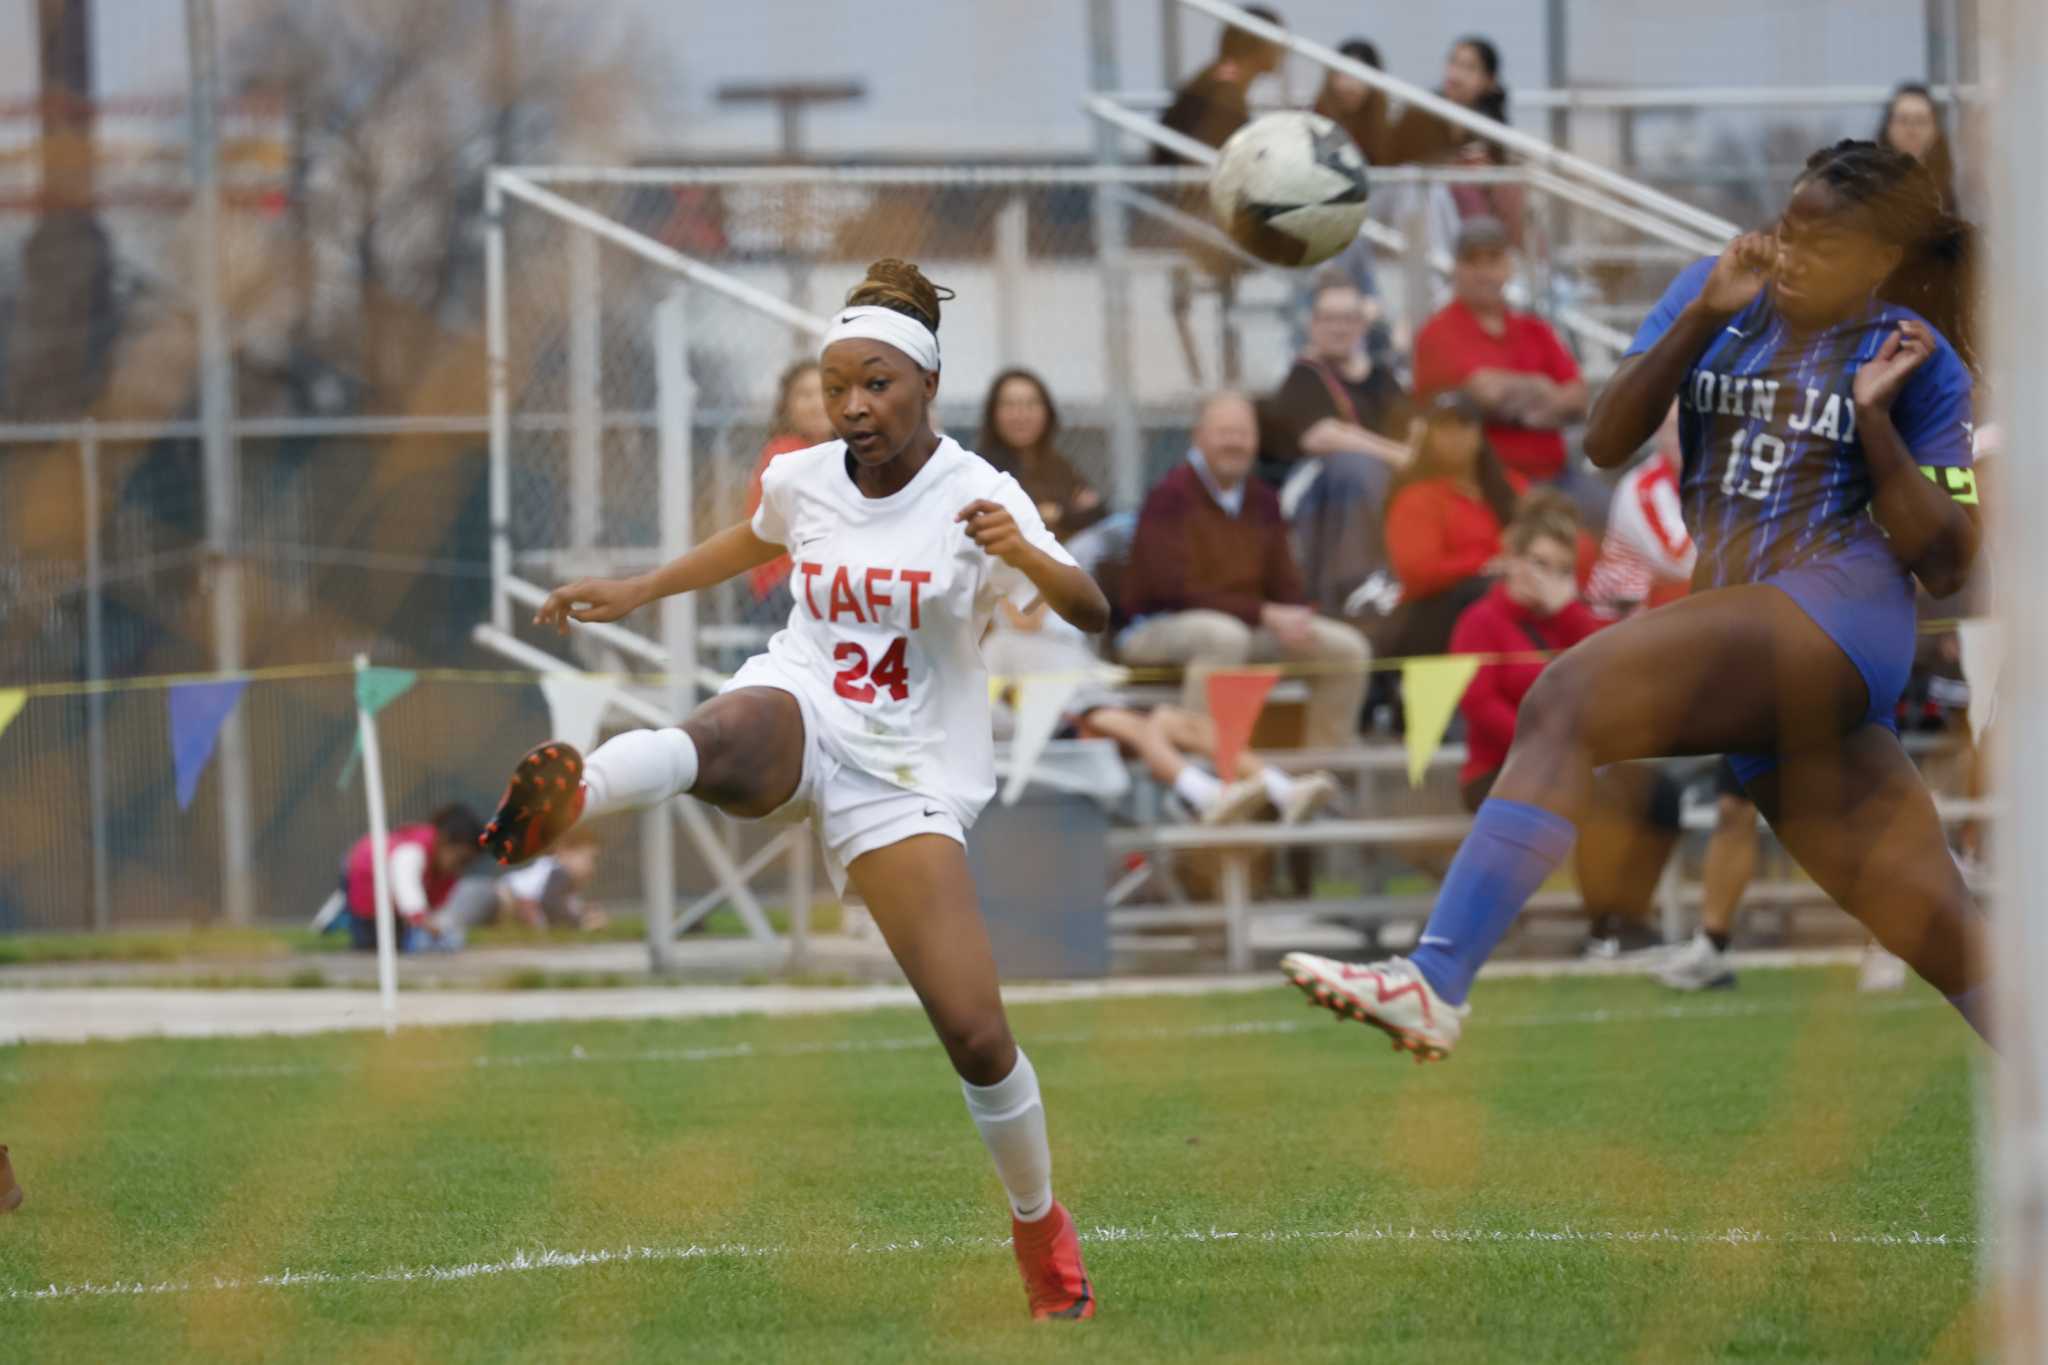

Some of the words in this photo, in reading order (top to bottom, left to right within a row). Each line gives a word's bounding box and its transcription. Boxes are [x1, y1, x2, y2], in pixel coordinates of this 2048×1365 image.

[1721, 428, 1785, 500] 19
[801, 562, 931, 630] TAFT
[833, 636, 909, 704] 24
